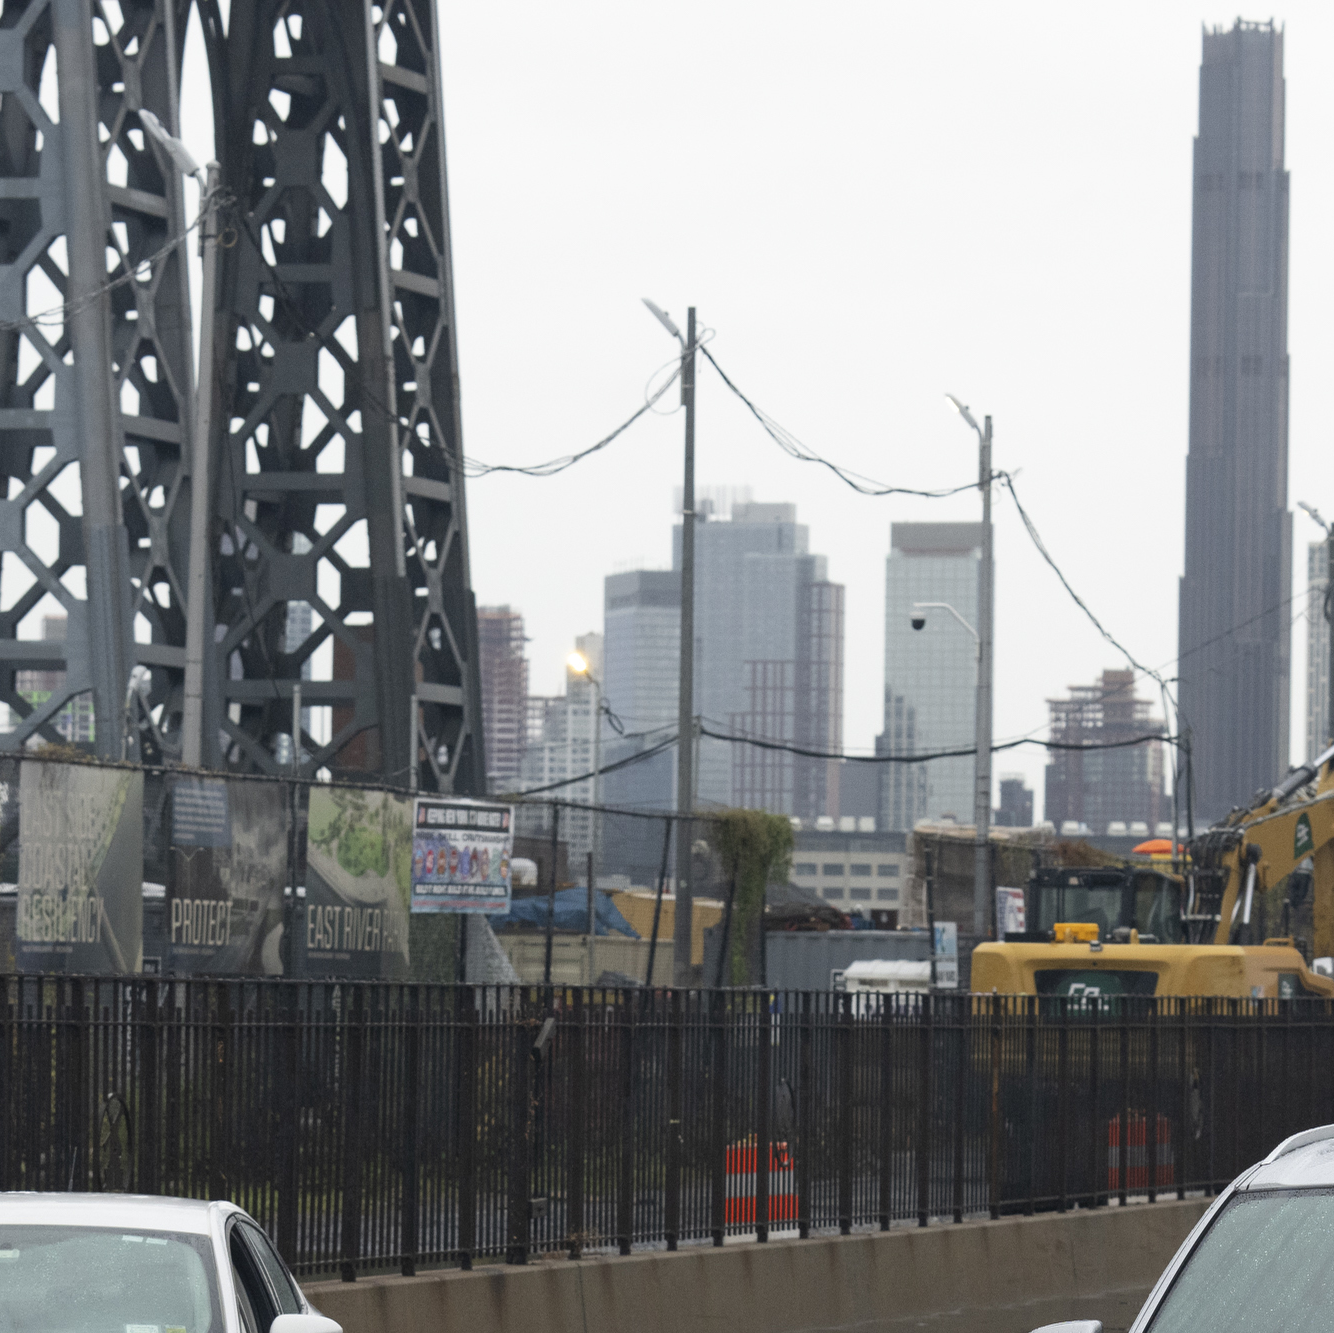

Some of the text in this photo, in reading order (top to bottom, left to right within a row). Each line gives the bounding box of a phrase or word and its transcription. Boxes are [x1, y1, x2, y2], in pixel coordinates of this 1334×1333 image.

[171, 898, 233, 946] PROTECT
[307, 905, 341, 950] EAST
[343, 907, 382, 952] RIVER
